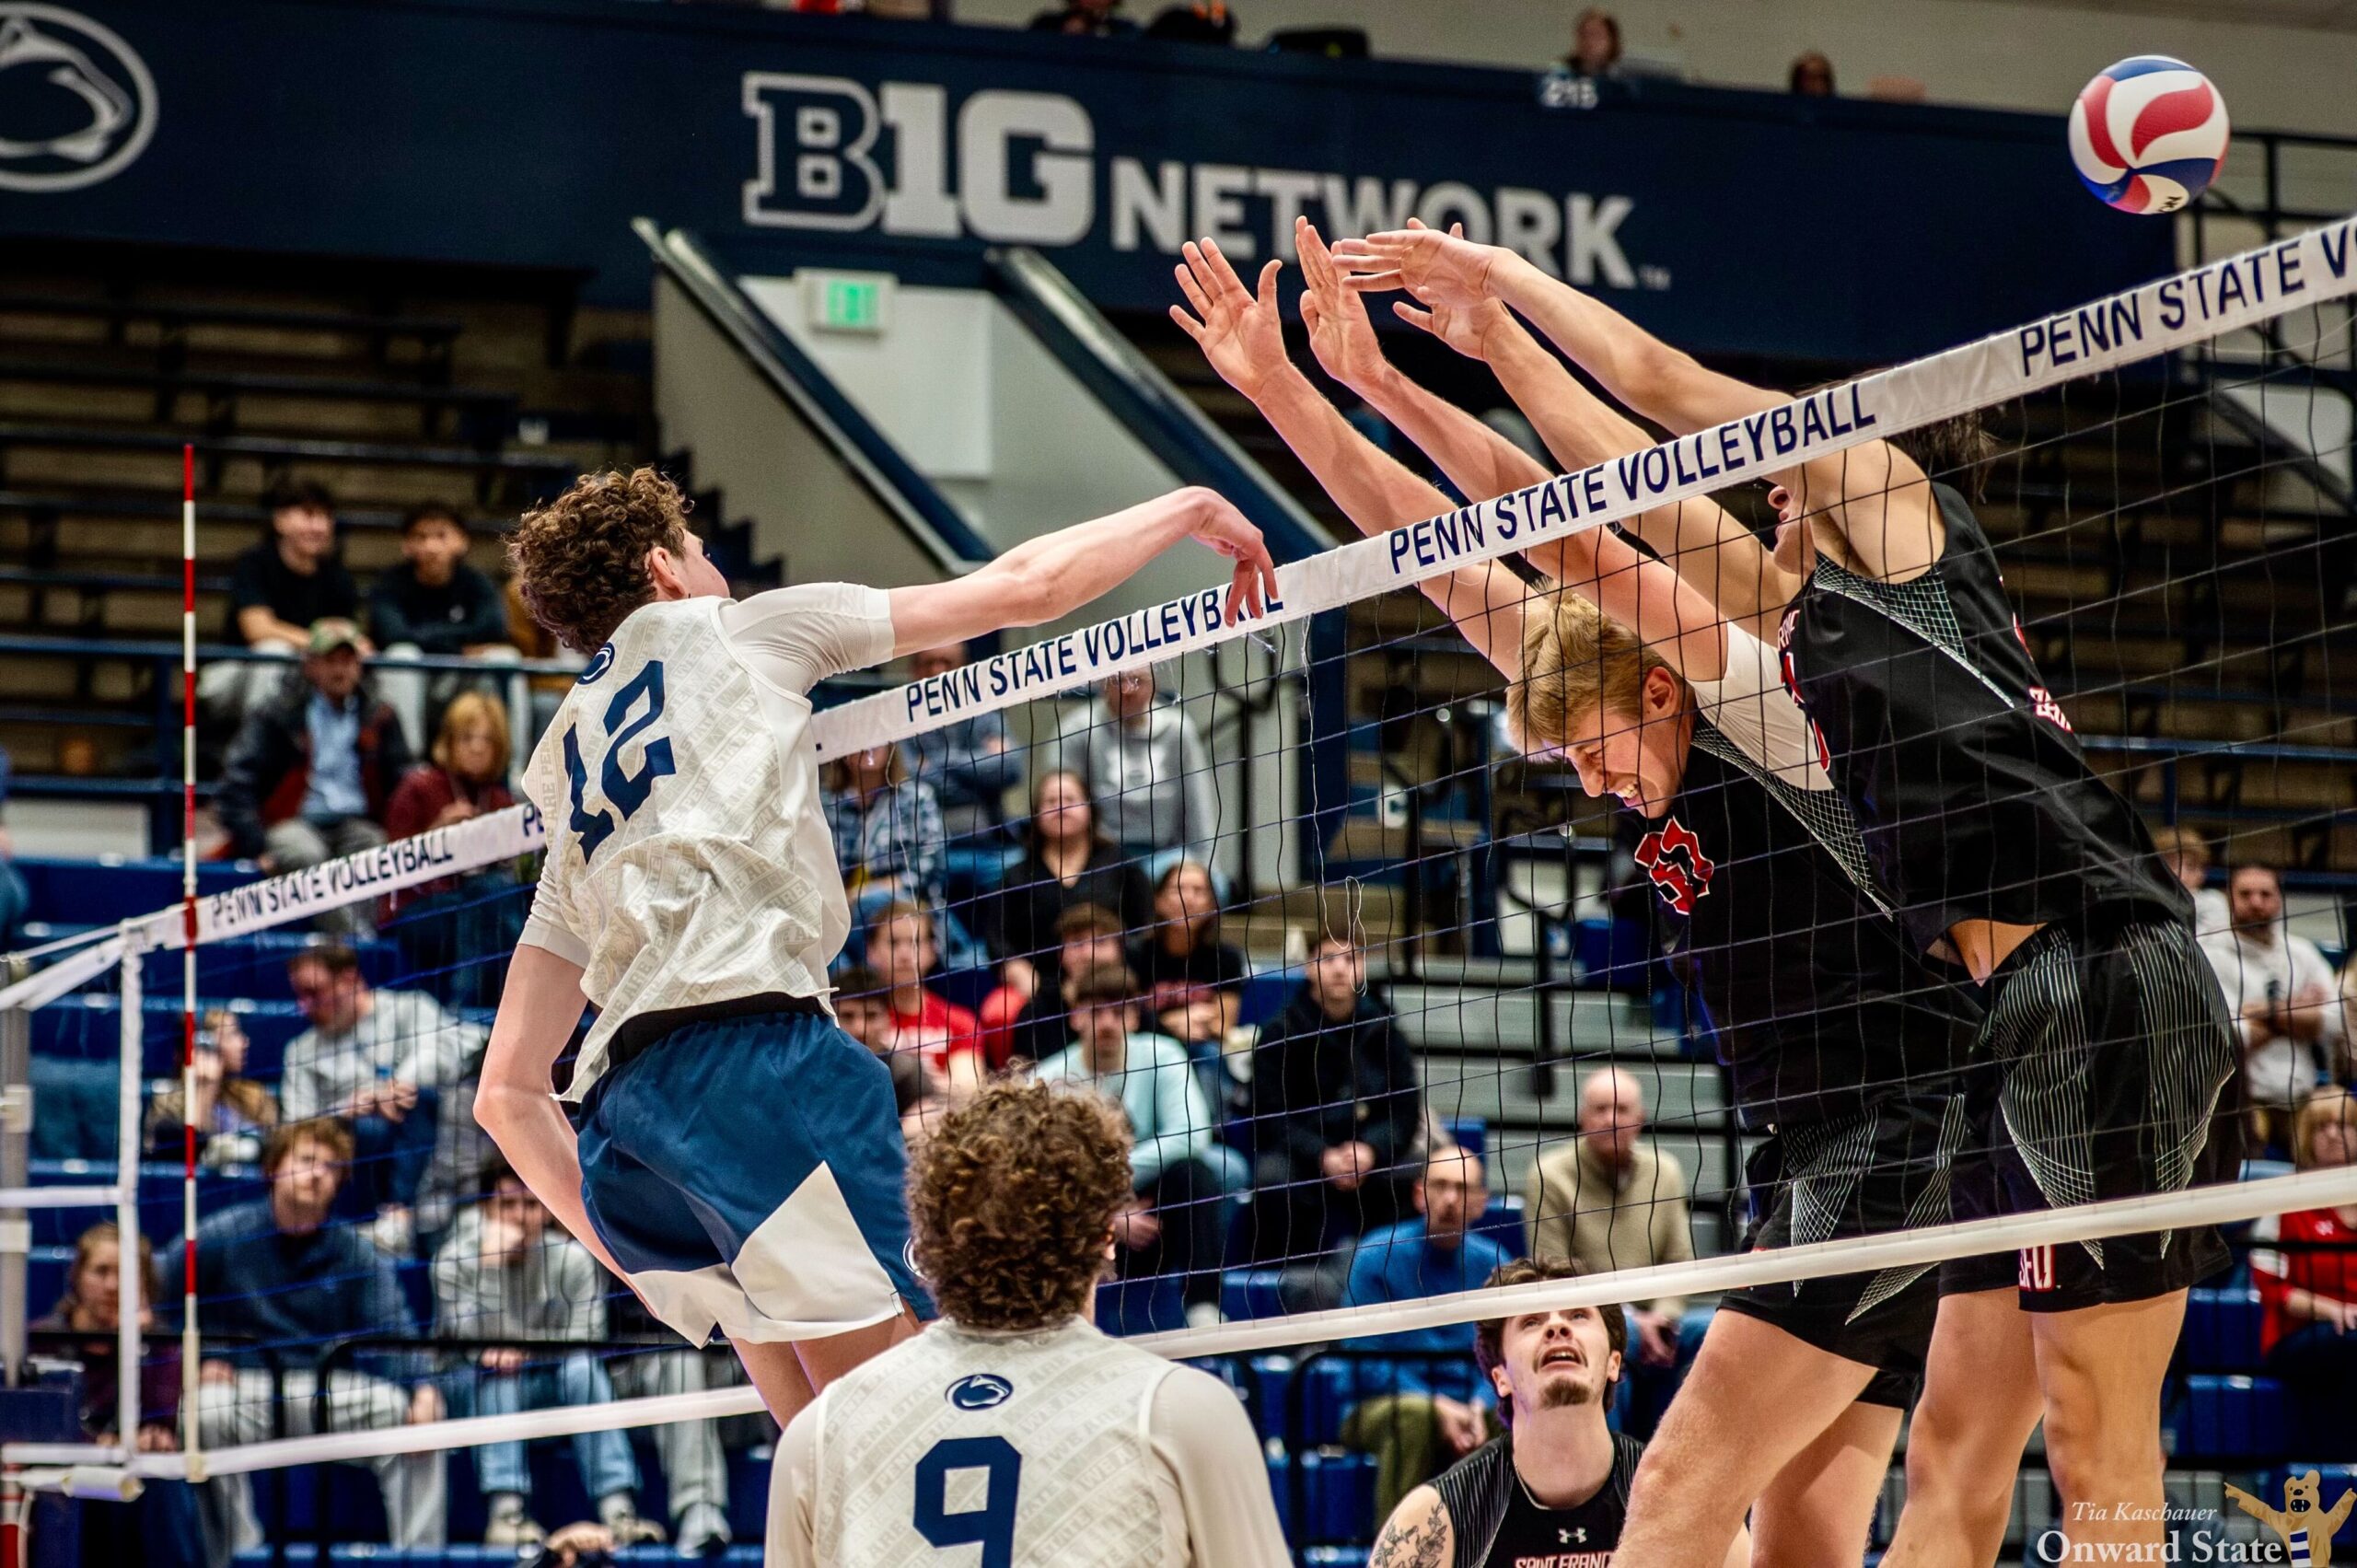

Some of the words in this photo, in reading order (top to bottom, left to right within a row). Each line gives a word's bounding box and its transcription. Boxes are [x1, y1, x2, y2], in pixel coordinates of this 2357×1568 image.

[1110, 155, 1636, 290] NETWORK
[2019, 292, 2143, 377] PENN
[2158, 240, 2305, 331] STATE
[1388, 502, 1486, 574] PENN
[1495, 463, 1607, 540] STATE
[1618, 382, 1876, 502] VOLLEYBALL
[906, 666, 981, 722] PENN
[991, 634, 1076, 697] STATE
[1084, 583, 1283, 668] VOLLEYBL
[563, 658, 677, 865] 12
[328, 831, 453, 894] VOLLEYBALL
[620, 959, 653, 1000] ARE
[912, 1436, 1021, 1568] 9
